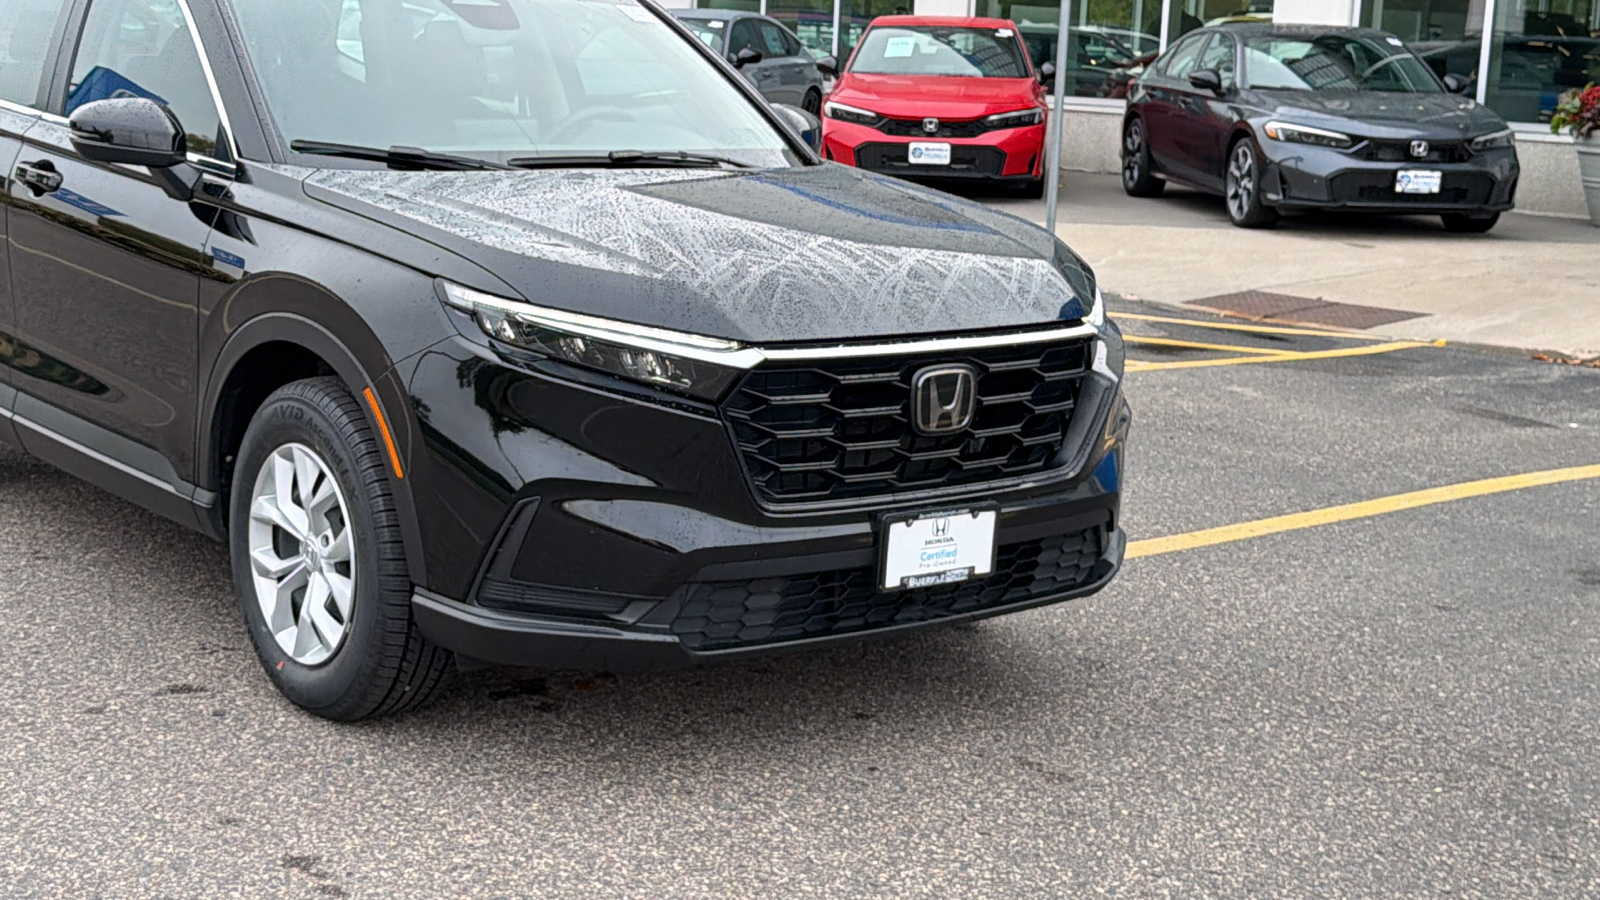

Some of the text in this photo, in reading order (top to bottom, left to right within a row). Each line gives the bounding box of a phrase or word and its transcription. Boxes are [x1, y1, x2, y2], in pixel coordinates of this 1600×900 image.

[271, 404, 304, 421] AVID
[924, 536, 955, 546] HONDA
[920, 547, 958, 562] Certified
[919, 559, 957, 569] Pre-Owned
